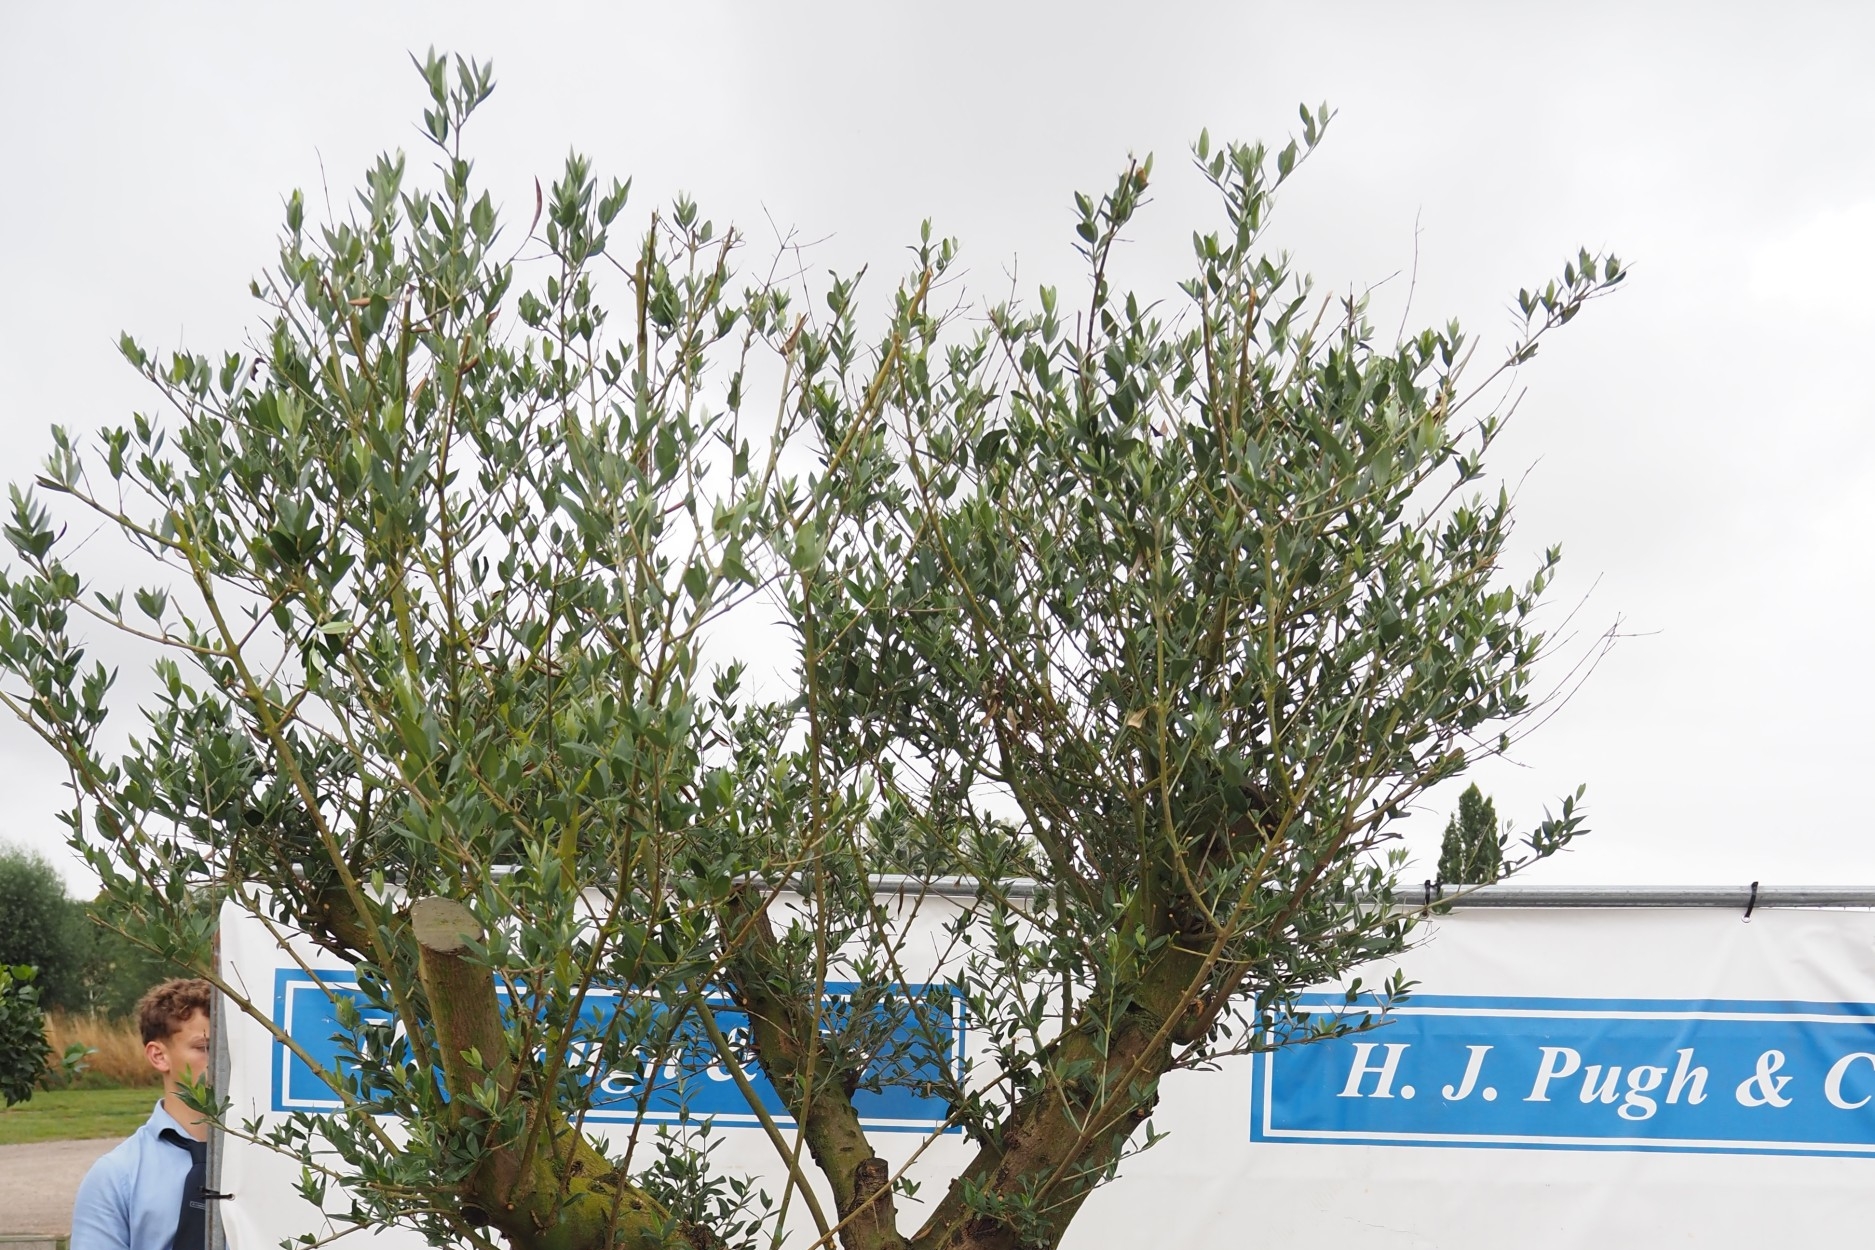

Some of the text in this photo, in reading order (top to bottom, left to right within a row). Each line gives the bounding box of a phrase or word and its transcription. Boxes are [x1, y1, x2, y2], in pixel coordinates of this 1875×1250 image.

[1337, 1042, 1416, 1100] H.
[1442, 1045, 1498, 1102] J.
[1523, 1046, 1708, 1121] Pugh
[1736, 1049, 1793, 1108] &
